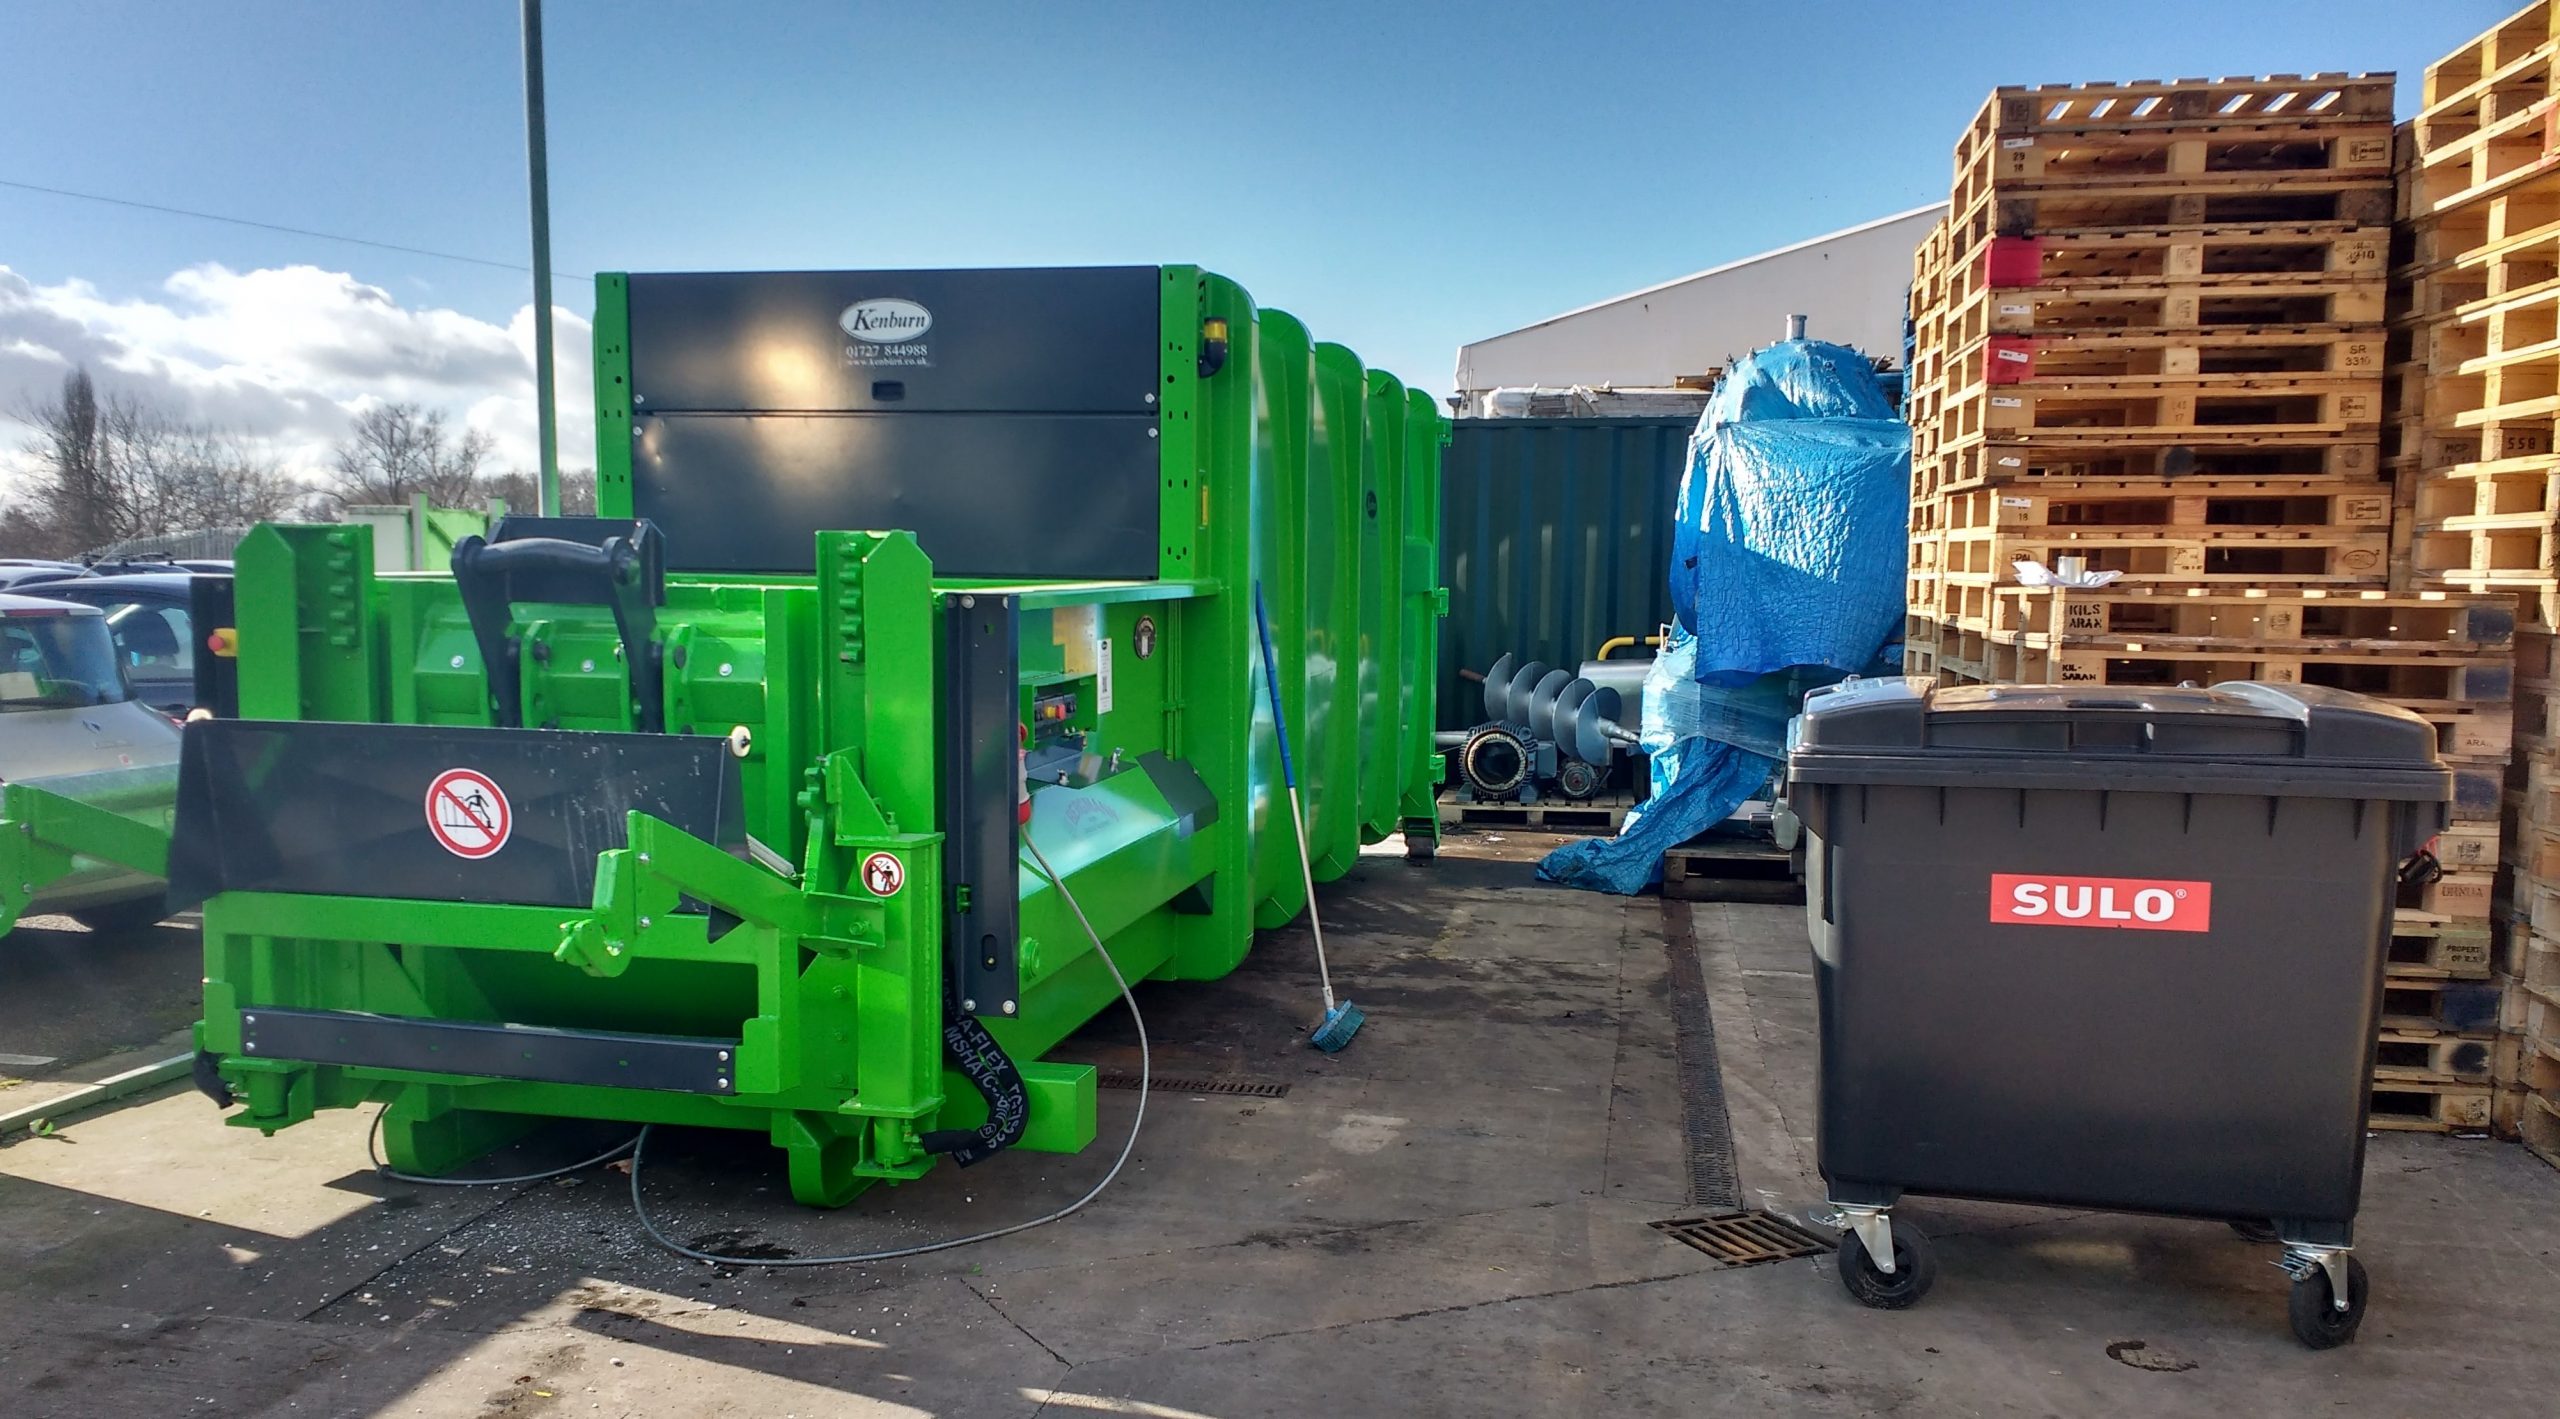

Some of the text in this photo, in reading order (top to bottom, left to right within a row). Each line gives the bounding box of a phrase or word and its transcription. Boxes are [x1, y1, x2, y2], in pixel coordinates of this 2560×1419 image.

[853, 309, 926, 331] Kenburn
[846, 344, 928, 358] 01727 844988
[2349, 344, 2367, 354] SR
[2069, 604, 2101, 616] KILS
[2062, 673, 2097, 681] SARAN
